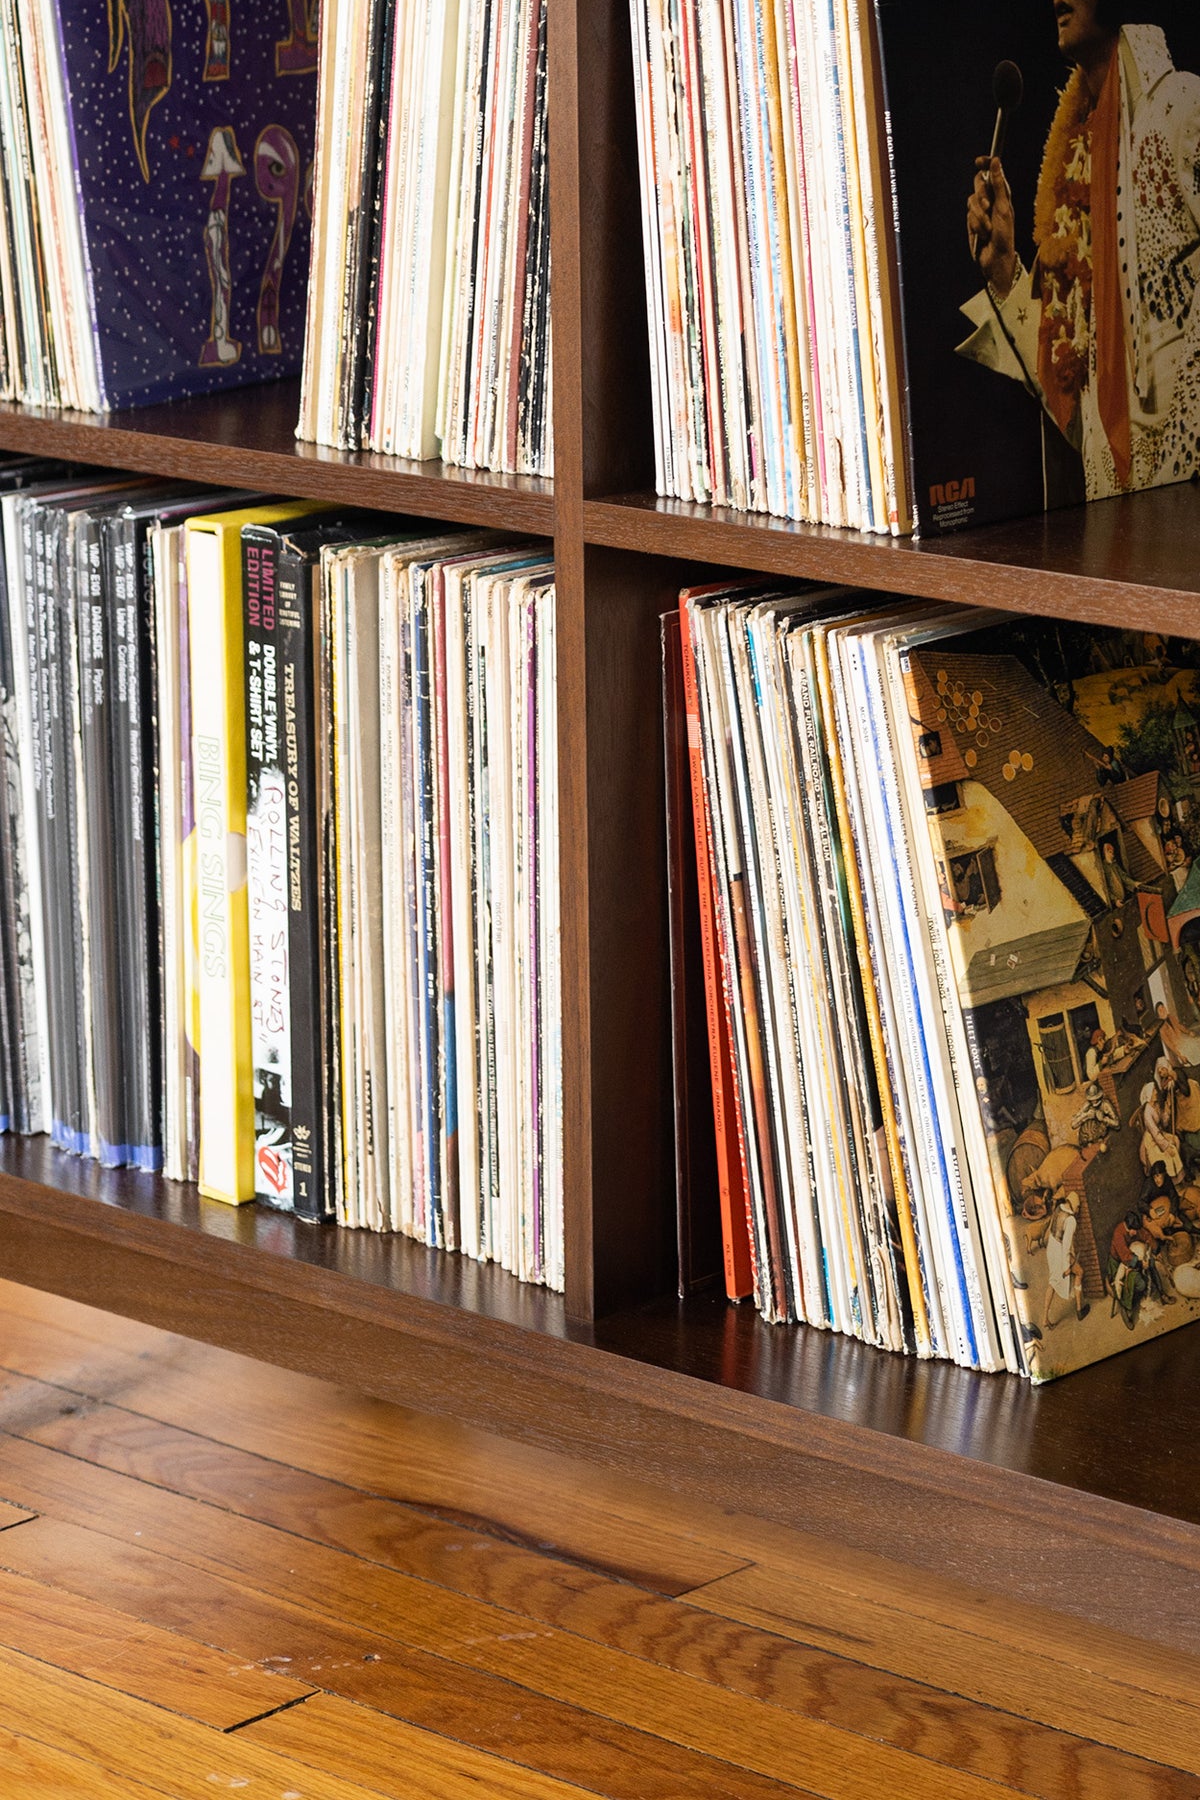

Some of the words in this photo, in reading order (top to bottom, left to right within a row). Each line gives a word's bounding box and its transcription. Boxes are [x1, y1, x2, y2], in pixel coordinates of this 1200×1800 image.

[836, 140, 845, 166] PIANO
[884, 111, 892, 134] PURE
[891, 194, 900, 232] PRESLEY
[800, 392, 814, 446] SERAPHIM
[929, 477, 976, 507] RCA
[933, 510, 962, 522] Reprocessed
[962, 507, 975, 517] from
[937, 503, 954, 514] Stereo
[954, 501, 969, 511] Effect
[939, 517, 968, 529] Monophonic
[79, 540, 89, 564] VMP
[89, 542, 100, 567] VMP
[115, 545, 125, 569] VMP
[124, 542, 133, 567] VMP
[90, 574, 101, 596] E101
[116, 576, 125, 599] E107
[246, 546, 261, 626] EDITION
[261, 548, 277, 630] LIMITED
[91, 606, 103, 659] DARKSIDE
[116, 607, 126, 638] Usher
[125, 605, 135, 643] Beverly
[248, 640, 261, 654] &
[93, 668, 104, 705] Psychic
[117, 644, 128, 702] Confessions
[127, 644, 137, 724] Glenn-Copeland
[262, 644, 278, 712] DOUBLE
[875, 668, 886, 697] MORE
[248, 660, 263, 727] T-SHIRT
[799, 670, 811, 708] GRAND
[283, 663, 298, 778] TREASURY
[683, 643, 694, 707] TCHAIKOVSKY
[690, 754, 698, 782] SWAN
[804, 710, 815, 738] FUNK
[880, 700, 890, 720] AND
[250, 729, 264, 761] SET
[264, 714, 279, 764] VINYL
[884, 723, 895, 751] MORE
[808, 740, 822, 792] RAILROAD
[890, 760, 900, 787] TONY
[197, 735, 224, 841] BING
[287, 782, 298, 810] OF
[895, 790, 908, 836] SANDLER
[259, 786, 286, 912] ROLLING
[819, 826, 831, 861] ALBUM
[288, 814, 302, 912] WALTZES
[904, 847, 915, 879] RALPH
[494, 901, 502, 926] DISCO
[909, 880, 921, 918] YOUNG
[200, 853, 226, 978] SINGS
[926, 916, 938, 944] JEWISH
[897, 952, 906, 968] THE
[932, 948, 942, 968] FOLK
[900, 970, 909, 986] BEST
[936, 973, 947, 1000] SONGS
[782, 934, 791, 953] THE
[790, 1006, 802, 1058] GREATEST
[903, 988, 913, 1014] LITTLE
[965, 1015, 977, 1039] FLEET
[908, 1018, 923, 1072] WHOREHOUSE
[944, 1024, 957, 1065] THEODORE
[969, 1042, 982, 1069] FOXES
[918, 1084, 928, 1108] TEXAS
[923, 1116, 935, 1153] ORIGINAL
[929, 1156, 938, 1176] CAST
[298, 1182, 308, 1196] 1
